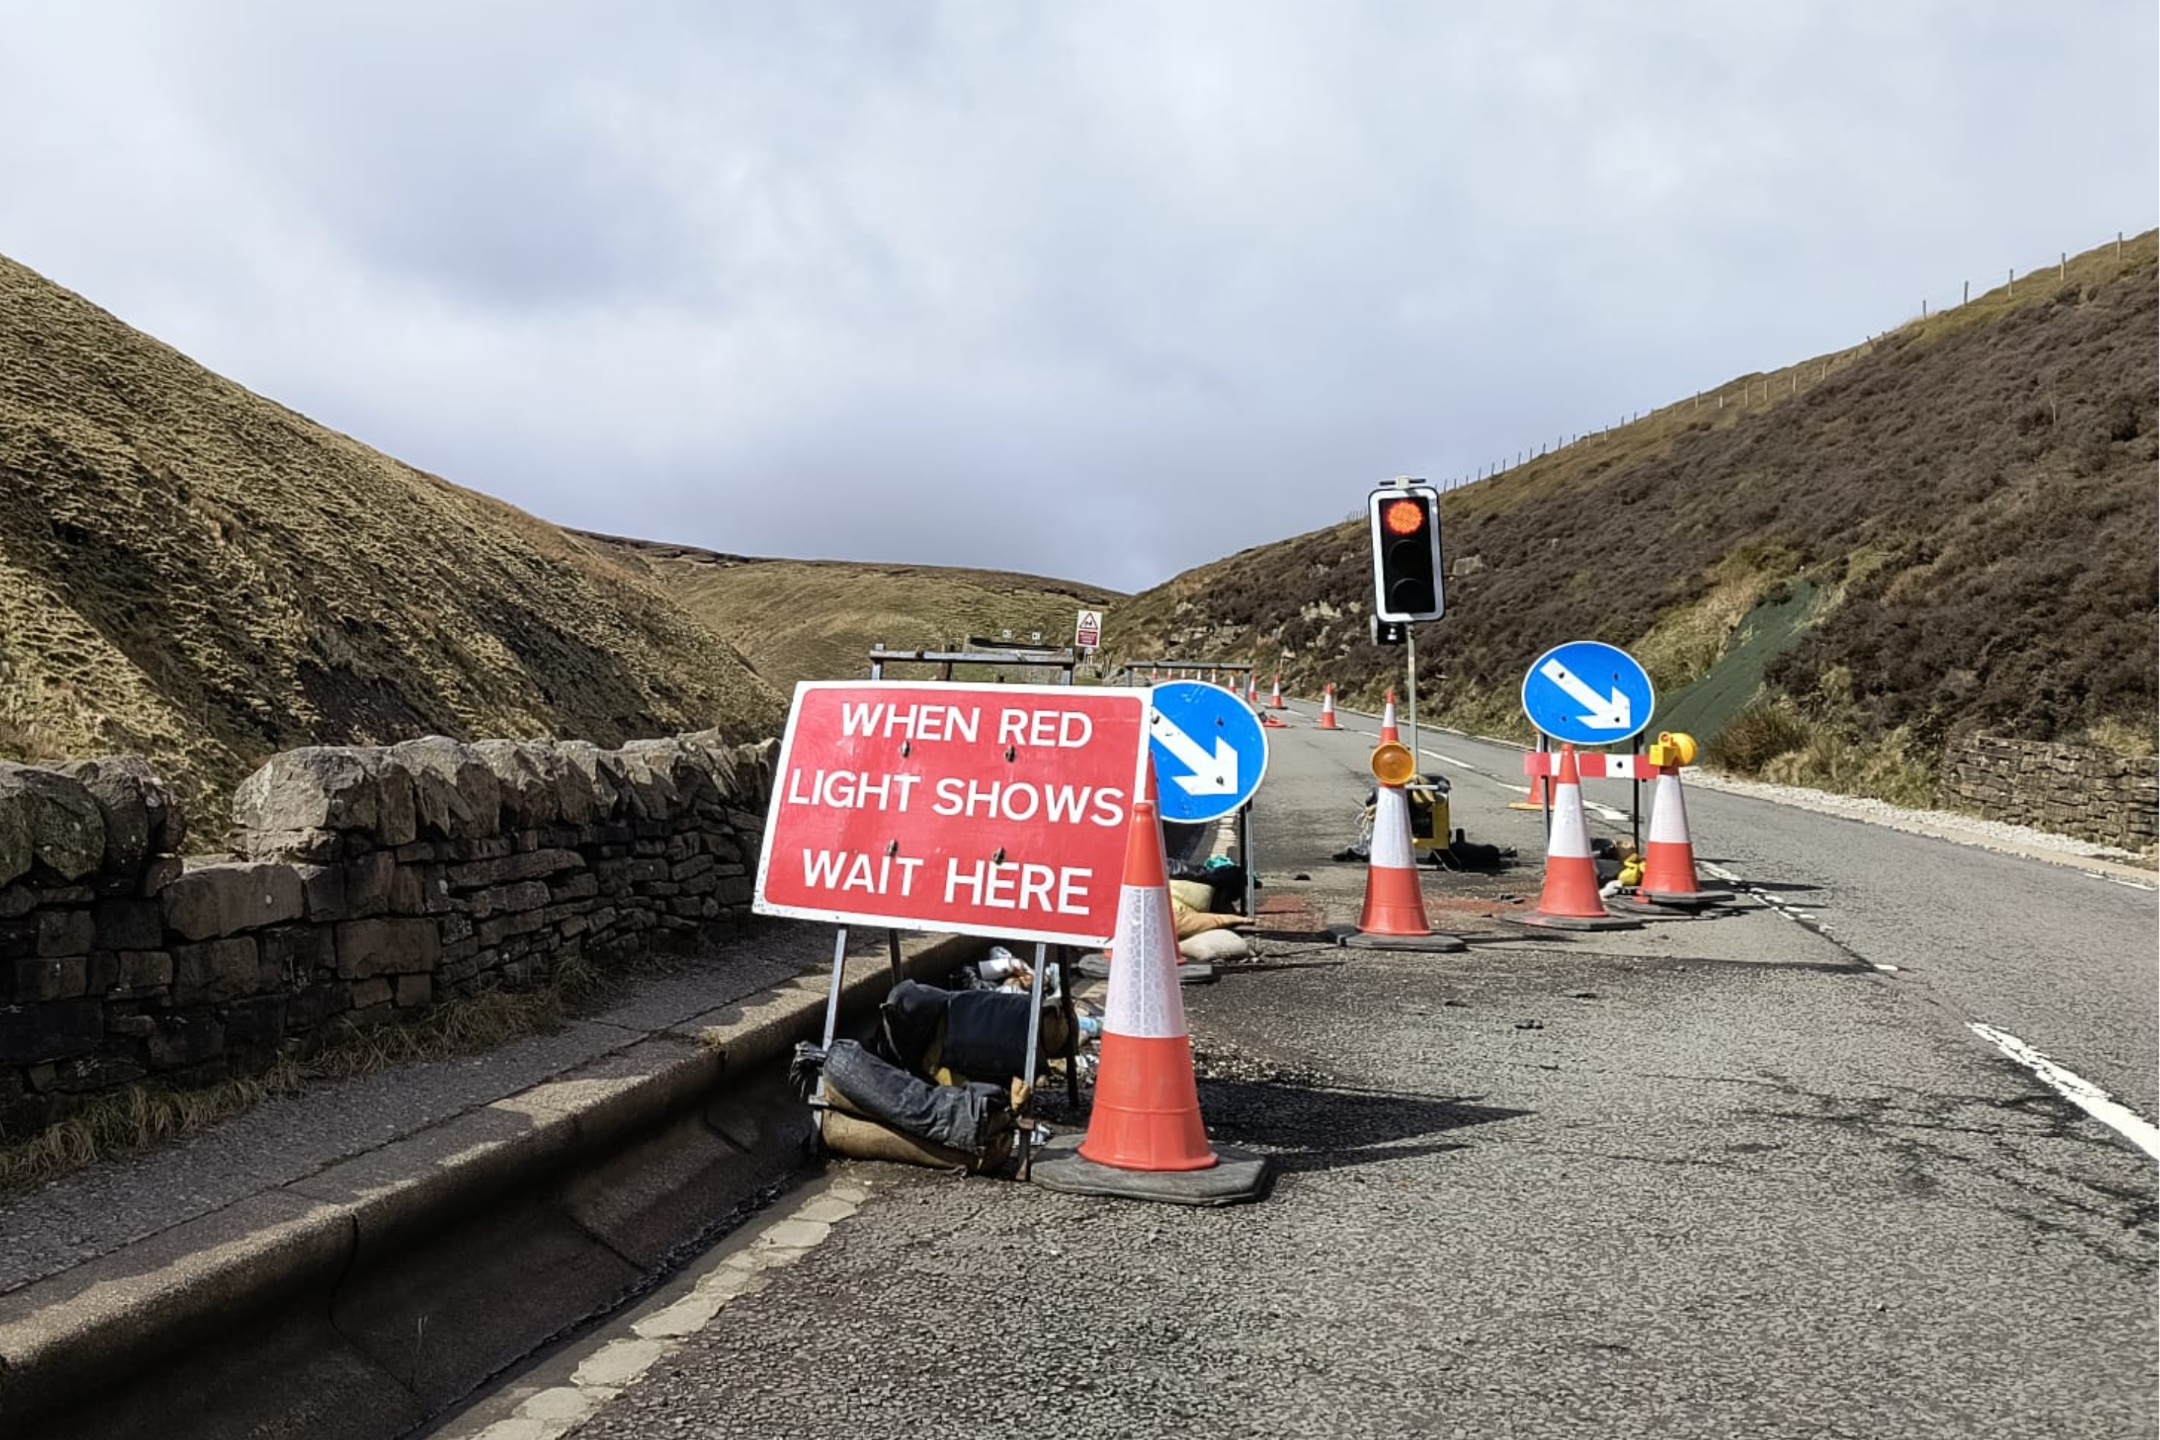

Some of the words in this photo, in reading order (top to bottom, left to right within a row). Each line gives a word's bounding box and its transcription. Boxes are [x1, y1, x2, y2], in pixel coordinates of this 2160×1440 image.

[841, 702, 981, 743] WHEN
[997, 708, 1093, 748] RED
[787, 768, 921, 812] LIGHT
[932, 778, 1125, 826] SHOWS
[802, 848, 924, 897] WAIT
[944, 858, 1093, 915] HERE
